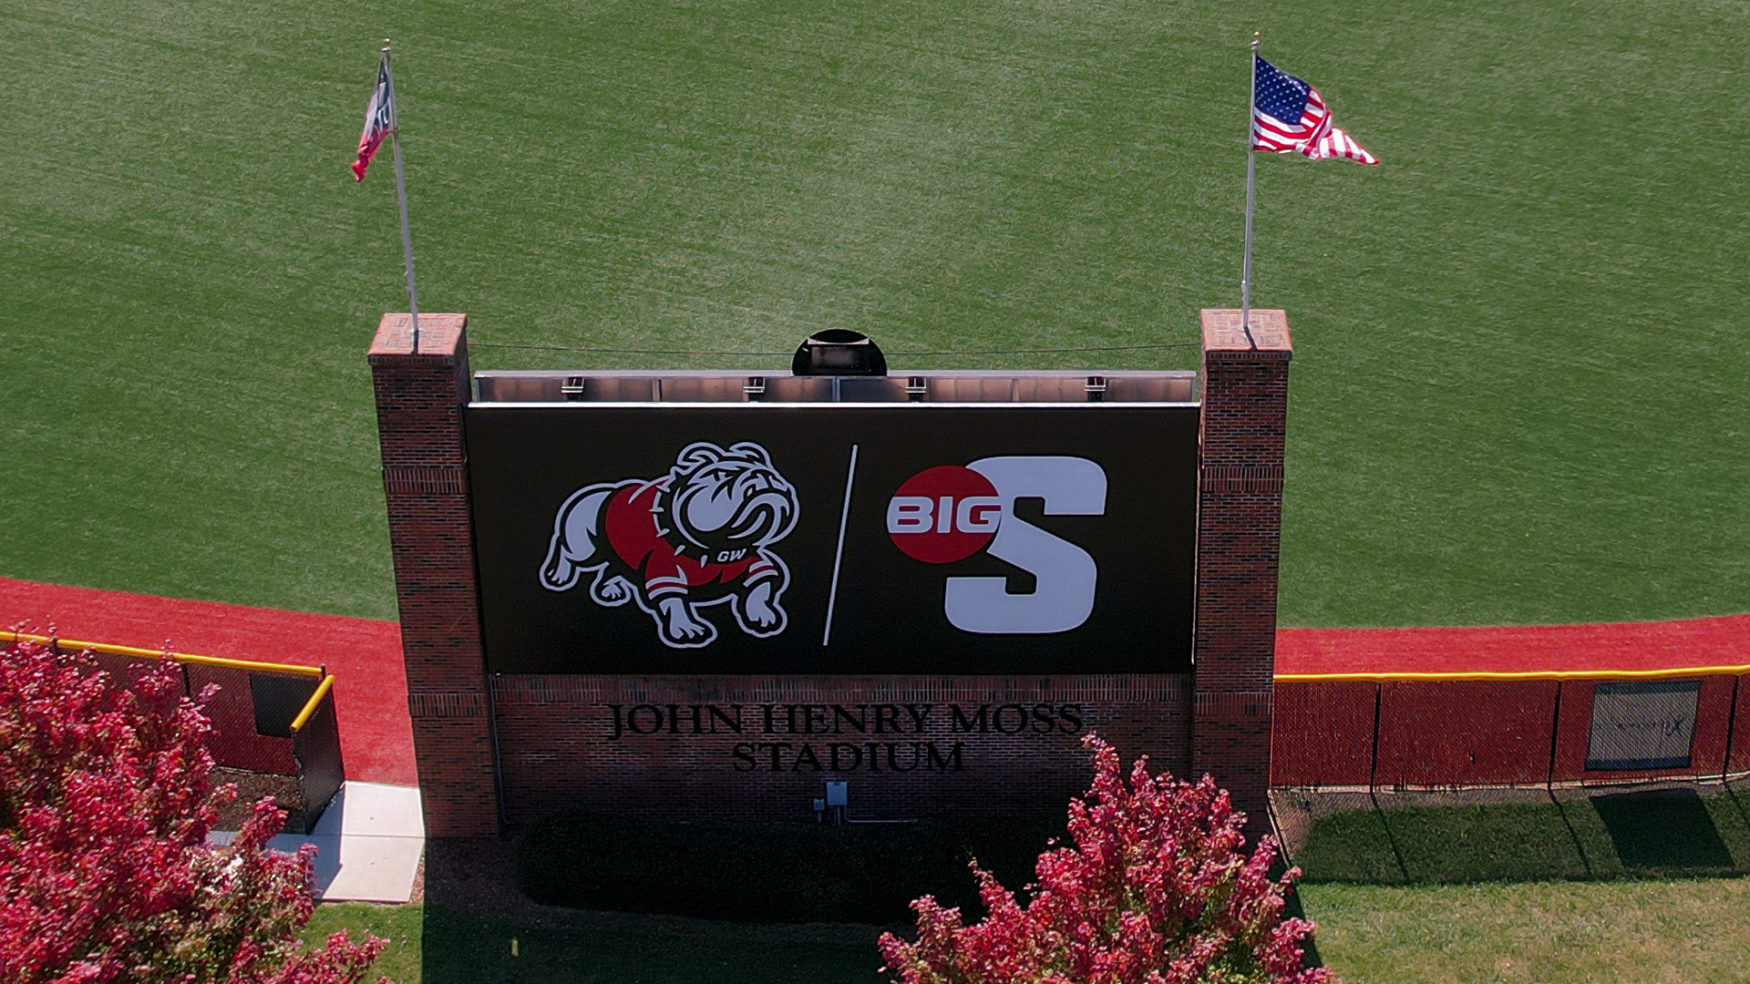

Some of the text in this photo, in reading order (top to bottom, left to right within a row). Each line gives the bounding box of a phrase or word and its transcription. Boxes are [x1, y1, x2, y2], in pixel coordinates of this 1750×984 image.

[717, 548, 747, 562] GW
[887, 456, 1107, 633] BIG S
[609, 704, 1083, 740] JOHN HENRY MOSS
[733, 742, 964, 772] STADIUM
